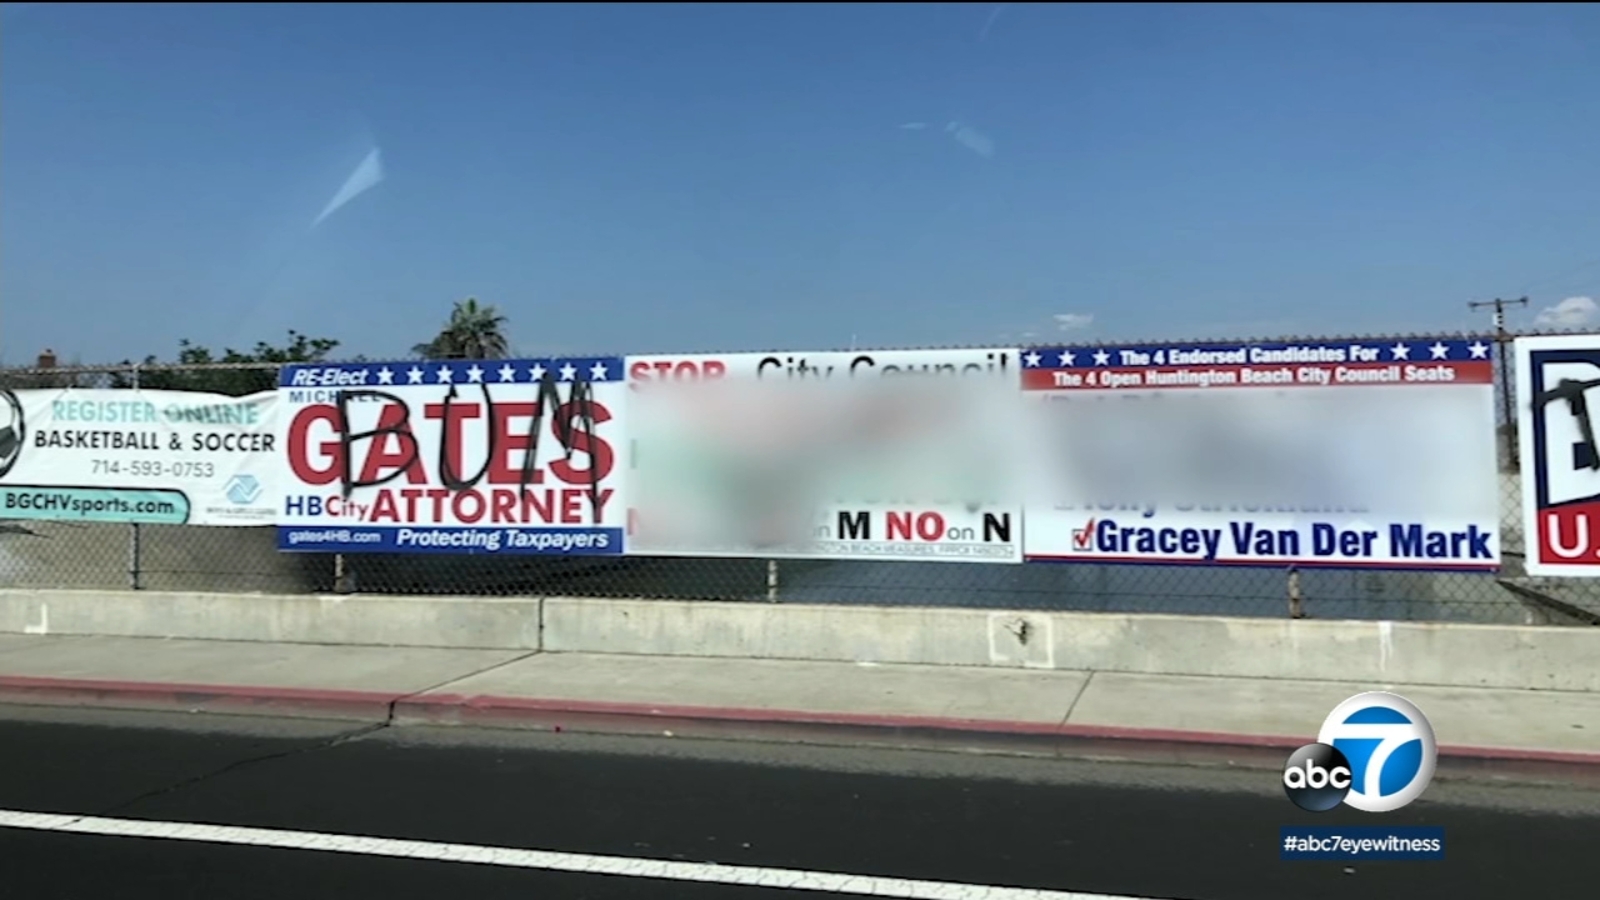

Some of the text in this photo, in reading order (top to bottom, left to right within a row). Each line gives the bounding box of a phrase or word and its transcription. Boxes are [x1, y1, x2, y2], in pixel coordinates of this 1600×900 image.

[1119, 345, 1379, 366] The 4 Endorsed Candidates For
[291, 368, 369, 386] RE-Elect
[1053, 364, 1455, 388] The 4 Open Huntington Beach City Council Seats
[289, 389, 380, 403] MICHL
[51, 400, 260, 425] REGISTER ONLINE
[34, 429, 276, 452] BASKETBALL & SOCCER
[286, 399, 615, 486] GATES
[91, 459, 215, 478] 714-593-0753
[5, 492, 175, 516] BGCHVsports.com
[838, 511, 871, 540] M
[885, 511, 946, 541] NO
[947, 526, 975, 541] on
[983, 512, 1011, 542] N
[288, 529, 609, 550] gates4HB.com Protecting Taxpayers
[1096, 519, 1494, 560] Gracey Van Der Mark
